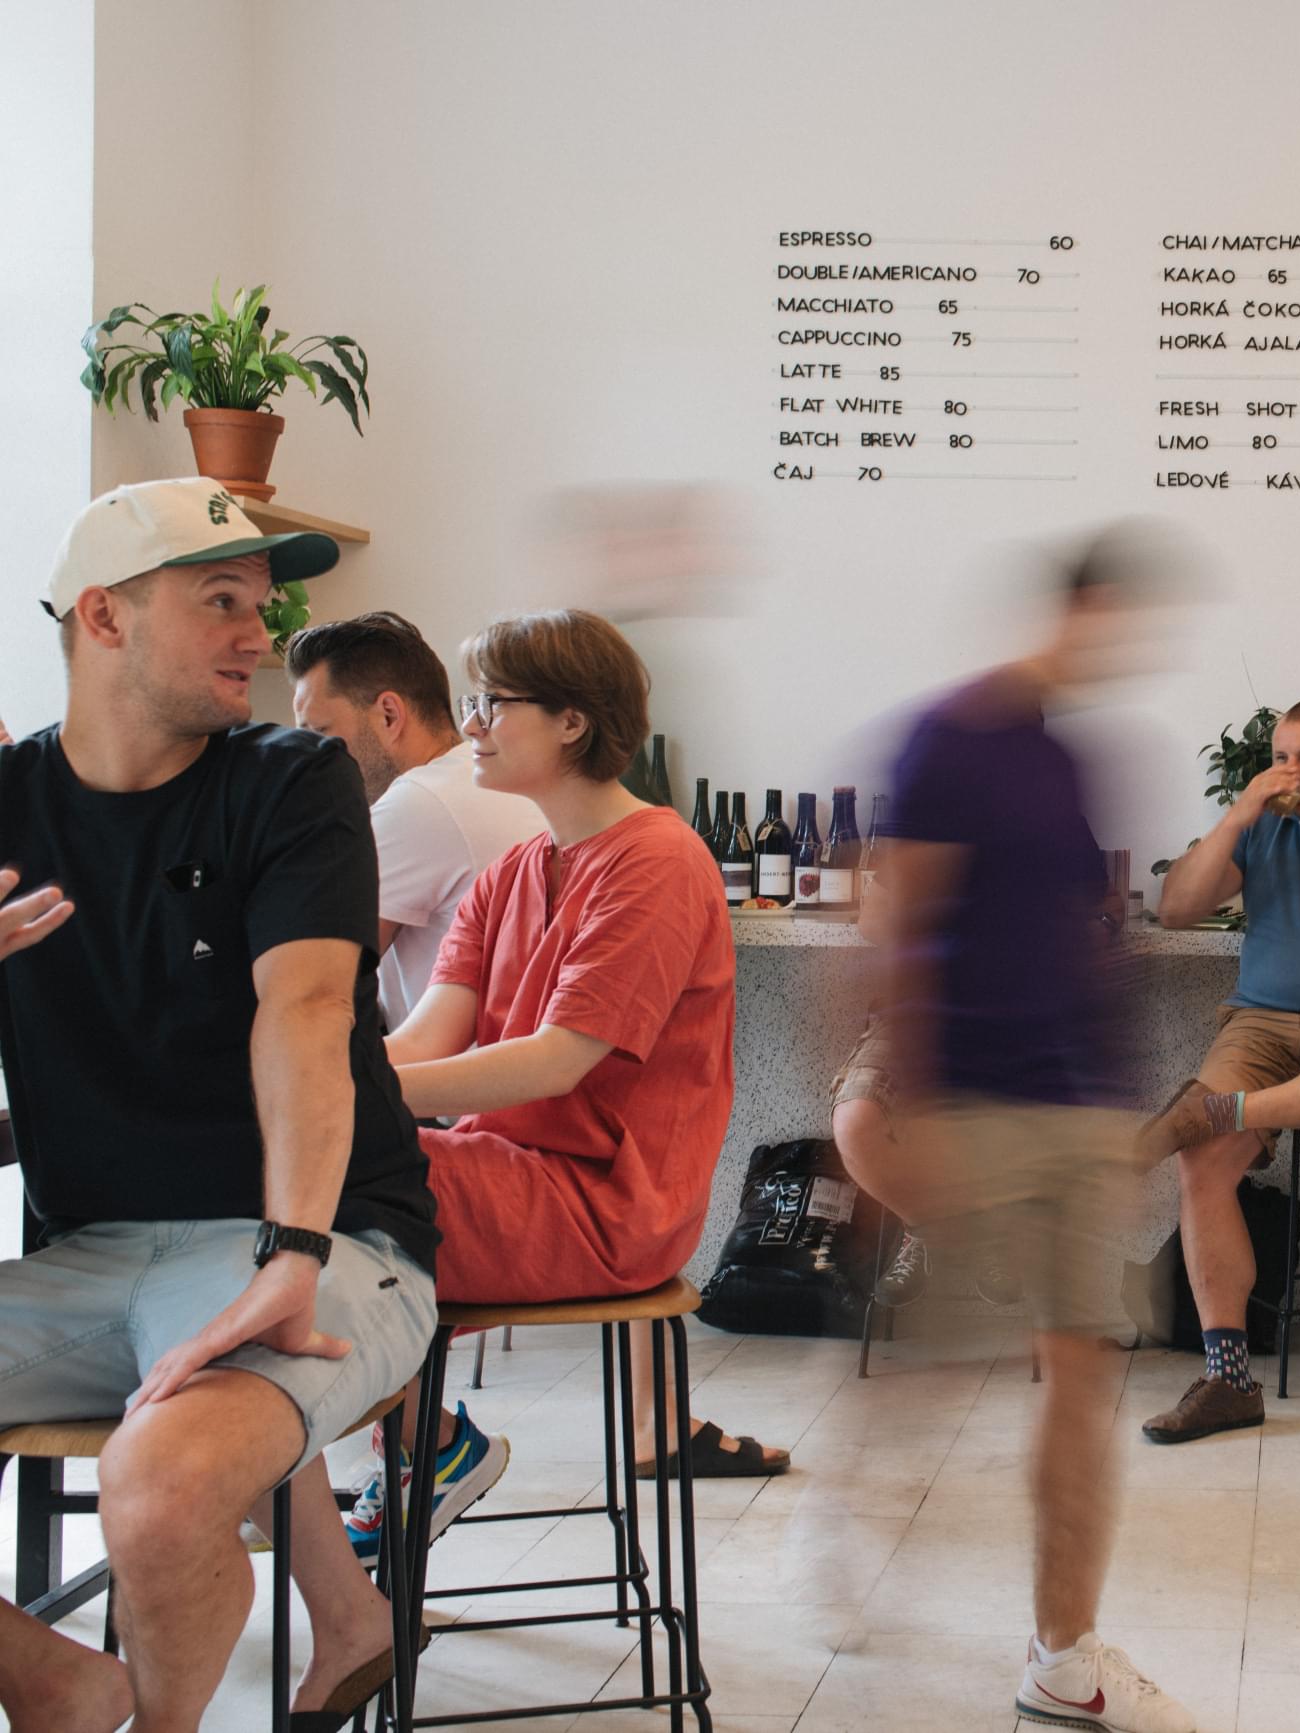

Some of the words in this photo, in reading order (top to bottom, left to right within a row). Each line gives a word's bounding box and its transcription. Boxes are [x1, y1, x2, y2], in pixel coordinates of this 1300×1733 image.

[780, 232, 872, 247] ESPRESSO
[1050, 236, 1074, 250] 60
[1018, 268, 1040, 284] 70
[1164, 267, 1235, 284] KAKAO
[1268, 269, 1287, 285] 65
[778, 297, 893, 314] MACCHIATO
[939, 300, 958, 314] 65
[1162, 299, 1229, 317] HORKÁ
[778, 330, 901, 347] CAPPUCCINO
[952, 332, 971, 347] 75
[1160, 332, 1227, 350] HORKÁ
[781, 364, 841, 378] LATTE
[880, 366, 900, 381] 85
[780, 397, 824, 413] FLAT
[836, 397, 902, 415] WHITE
[944, 400, 967, 416] 80
[1160, 401, 1219, 416] FRESH
[1247, 402, 1297, 418] SHOT
[780, 432, 839, 447] BATCH
[861, 432, 916, 447] BREW
[949, 434, 973, 448] 80
[1159, 435, 1208, 450] LIMO
[1252, 435, 1277, 450] 80
[774, 462, 813, 480] ČAJ
[858, 467, 882, 481] 70
[1157, 471, 1229, 488] LEDOVÉ
